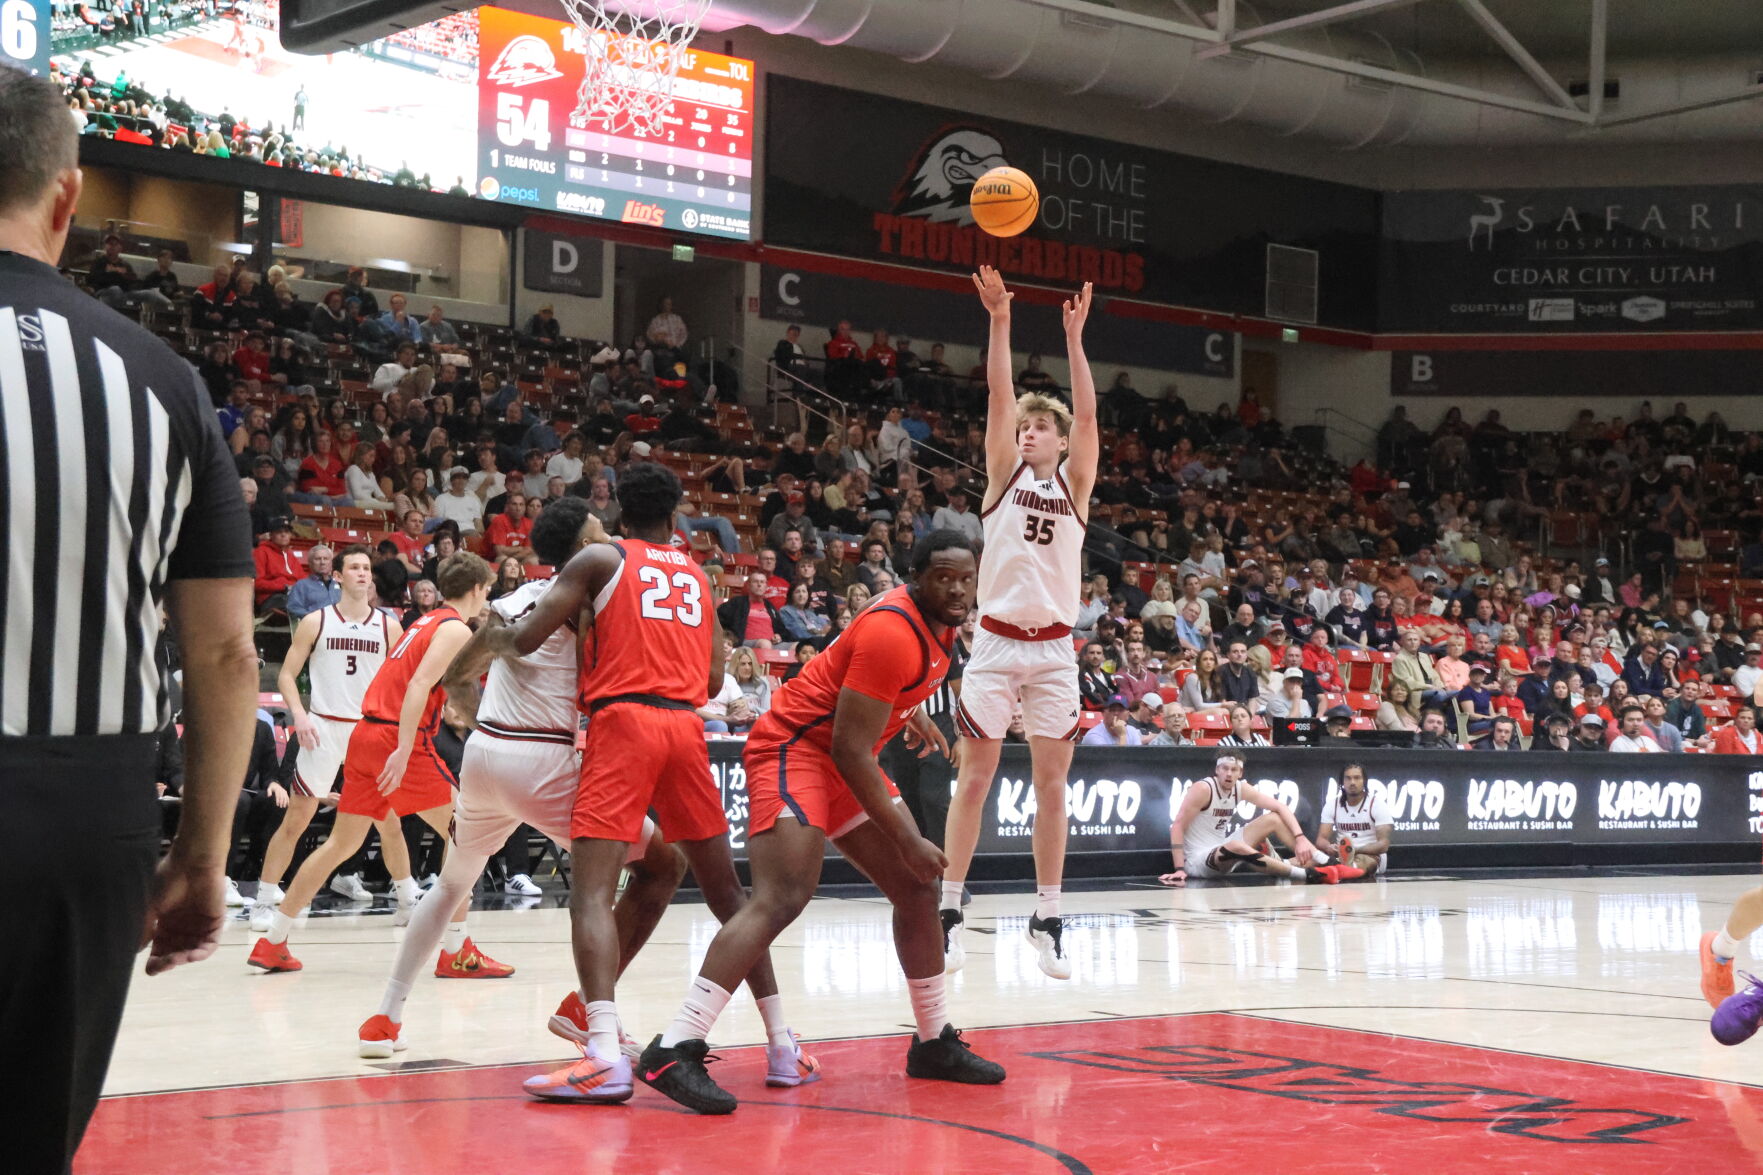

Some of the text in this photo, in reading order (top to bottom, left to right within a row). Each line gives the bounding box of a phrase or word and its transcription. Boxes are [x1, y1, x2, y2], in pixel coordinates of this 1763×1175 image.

[1, 0, 37, 60] 6
[729, 62, 750, 81] TOL
[496, 91, 551, 151] 54
[667, 131, 675, 142] 2
[698, 137, 705, 147] 0
[490, 149, 556, 174] 1 TEAM FOULS
[602, 153, 609, 165] 2
[635, 160, 643, 171] 1
[1042, 148, 1147, 197] HOME
[601, 170, 609, 182] 1
[635, 176, 643, 187] 1
[667, 182, 675, 193] 1
[973, 184, 1012, 196] Wilson
[622, 200, 666, 227] Lin's
[700, 213, 725, 224] STATE
[1041, 195, 1145, 243] OF THE
[1516, 202, 1742, 233] SAFARI
[873, 212, 1145, 292] THUNDERBIRDS
[1535, 236, 1722, 250] HOSPITALITY
[552, 240, 579, 274] D
[1493, 267, 1569, 286] CEDAR
[1651, 265, 1715, 284] UTAH
[778, 273, 801, 306] C
[1450, 303, 1525, 313] COURTYARD
[1205, 333, 1224, 362] C
[1411, 354, 1433, 381] B
[1023, 514, 1056, 546] 35
[645, 547, 688, 567] ARIYIBI
[639, 565, 702, 629] 23
[326, 637, 380, 654] THUNDERBIRDS
[345, 655, 357, 675] 3
[1294, 721, 1311, 731] POSS
[1467, 778, 1577, 821] KABUTO
[1598, 779, 1702, 820] KABUTO
[1081, 825, 1111, 835] SUSHI
[1115, 825, 1136, 835] BAR
[1394, 821, 1440, 831] SUSHI BAR
[1467, 821, 1573, 830] RESTAURANT & SUSHI BAR
[1599, 820, 1699, 829] RESTAURANT & SUSHI BAR
